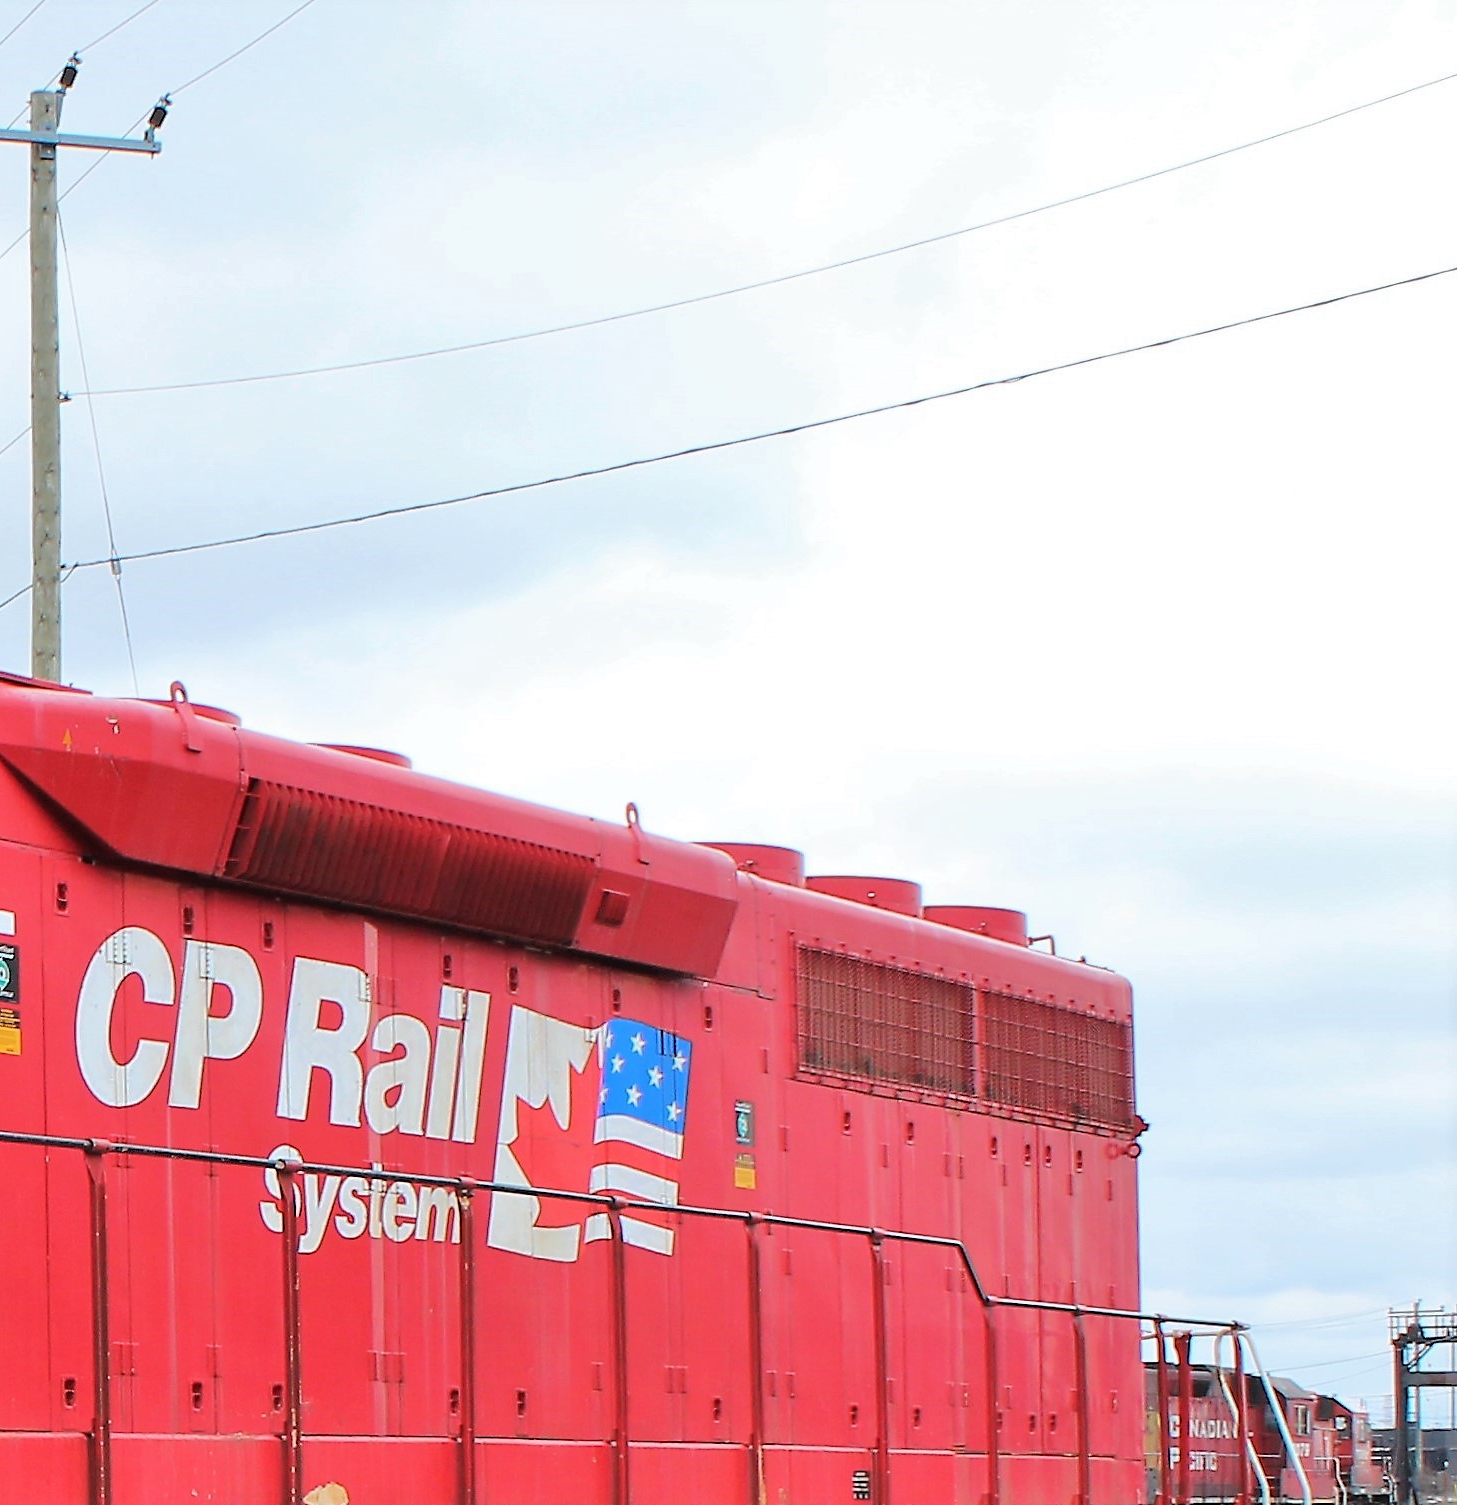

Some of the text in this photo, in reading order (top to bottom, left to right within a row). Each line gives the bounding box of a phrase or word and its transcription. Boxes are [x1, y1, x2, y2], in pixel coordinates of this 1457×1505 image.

[74, 925, 491, 1144] CP Rail
[259, 1144, 461, 1254] System
